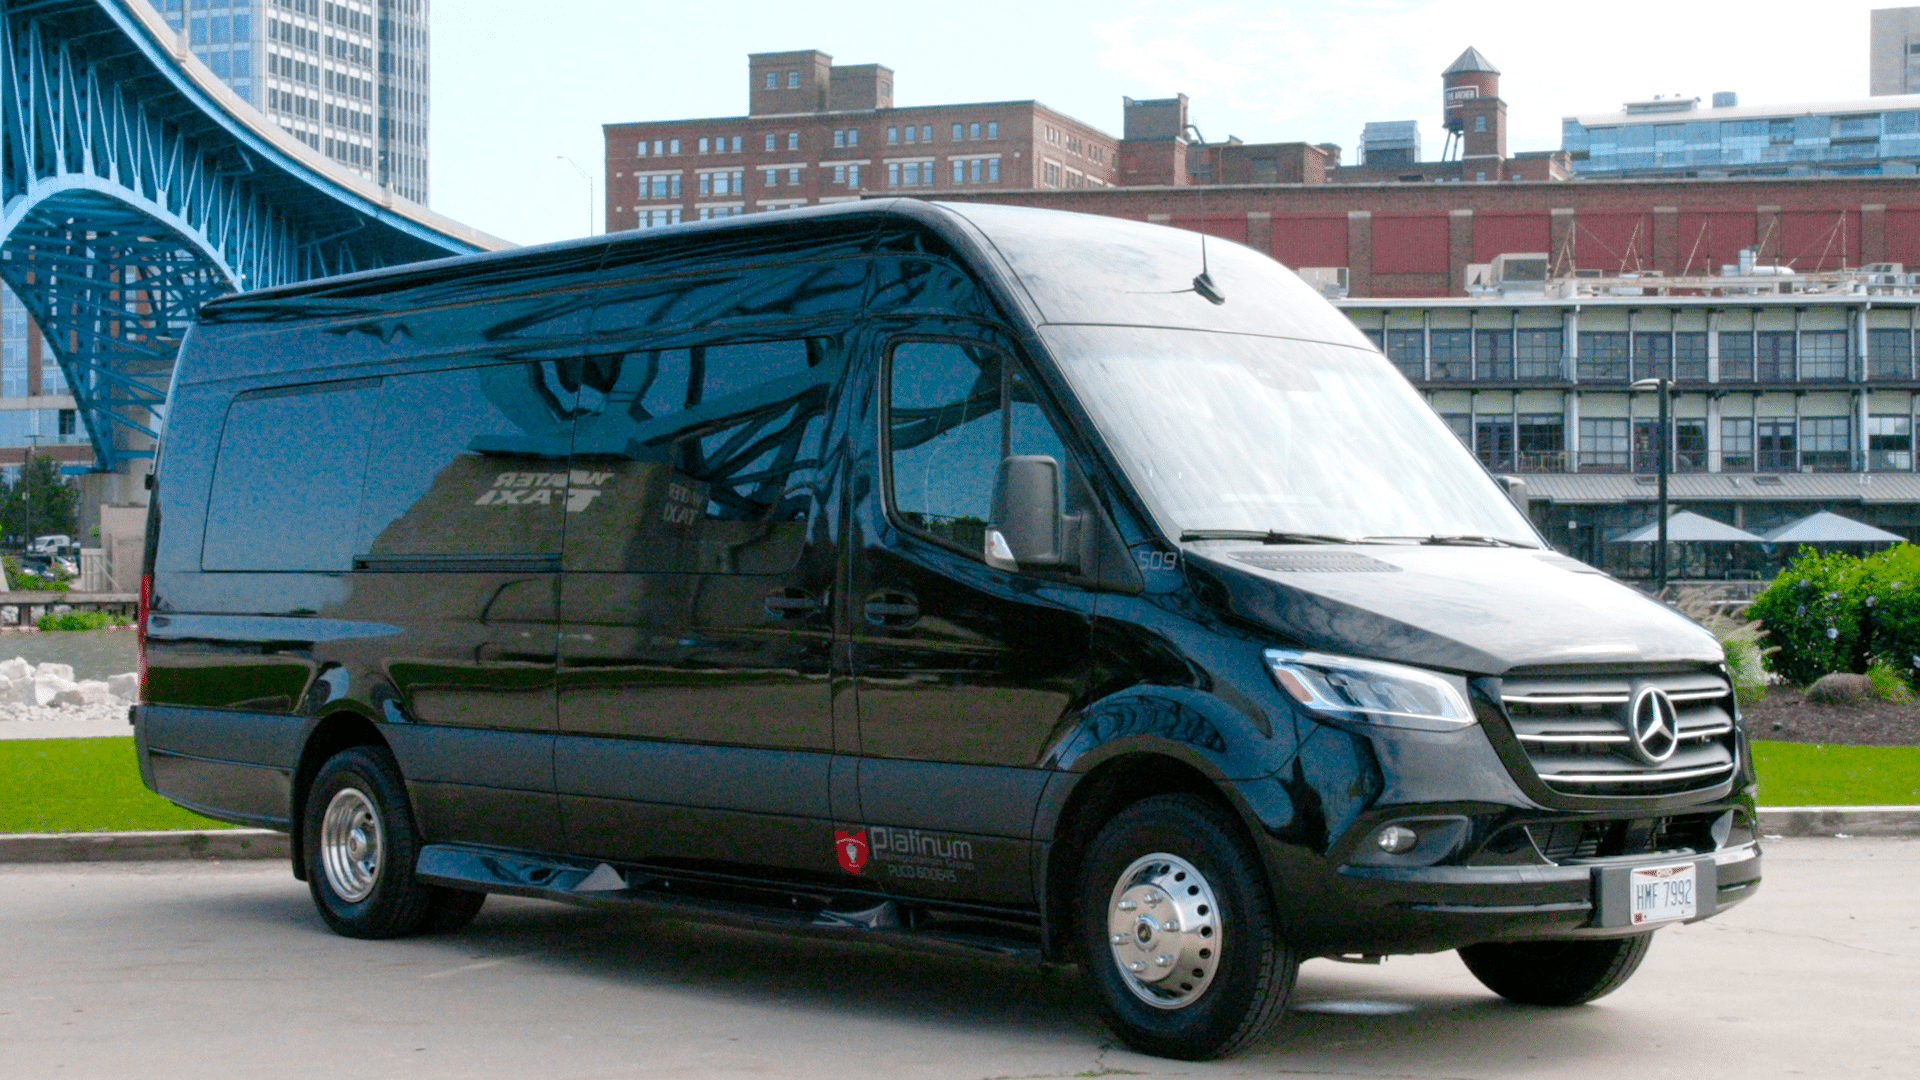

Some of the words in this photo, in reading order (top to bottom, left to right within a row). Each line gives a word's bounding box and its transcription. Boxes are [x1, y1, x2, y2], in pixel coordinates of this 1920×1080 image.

[1139, 551, 1177, 570] 509
[870, 826, 973, 860] Platinum
[1636, 882, 1659, 910] HMF
[1663, 879, 1692, 908] 7992
